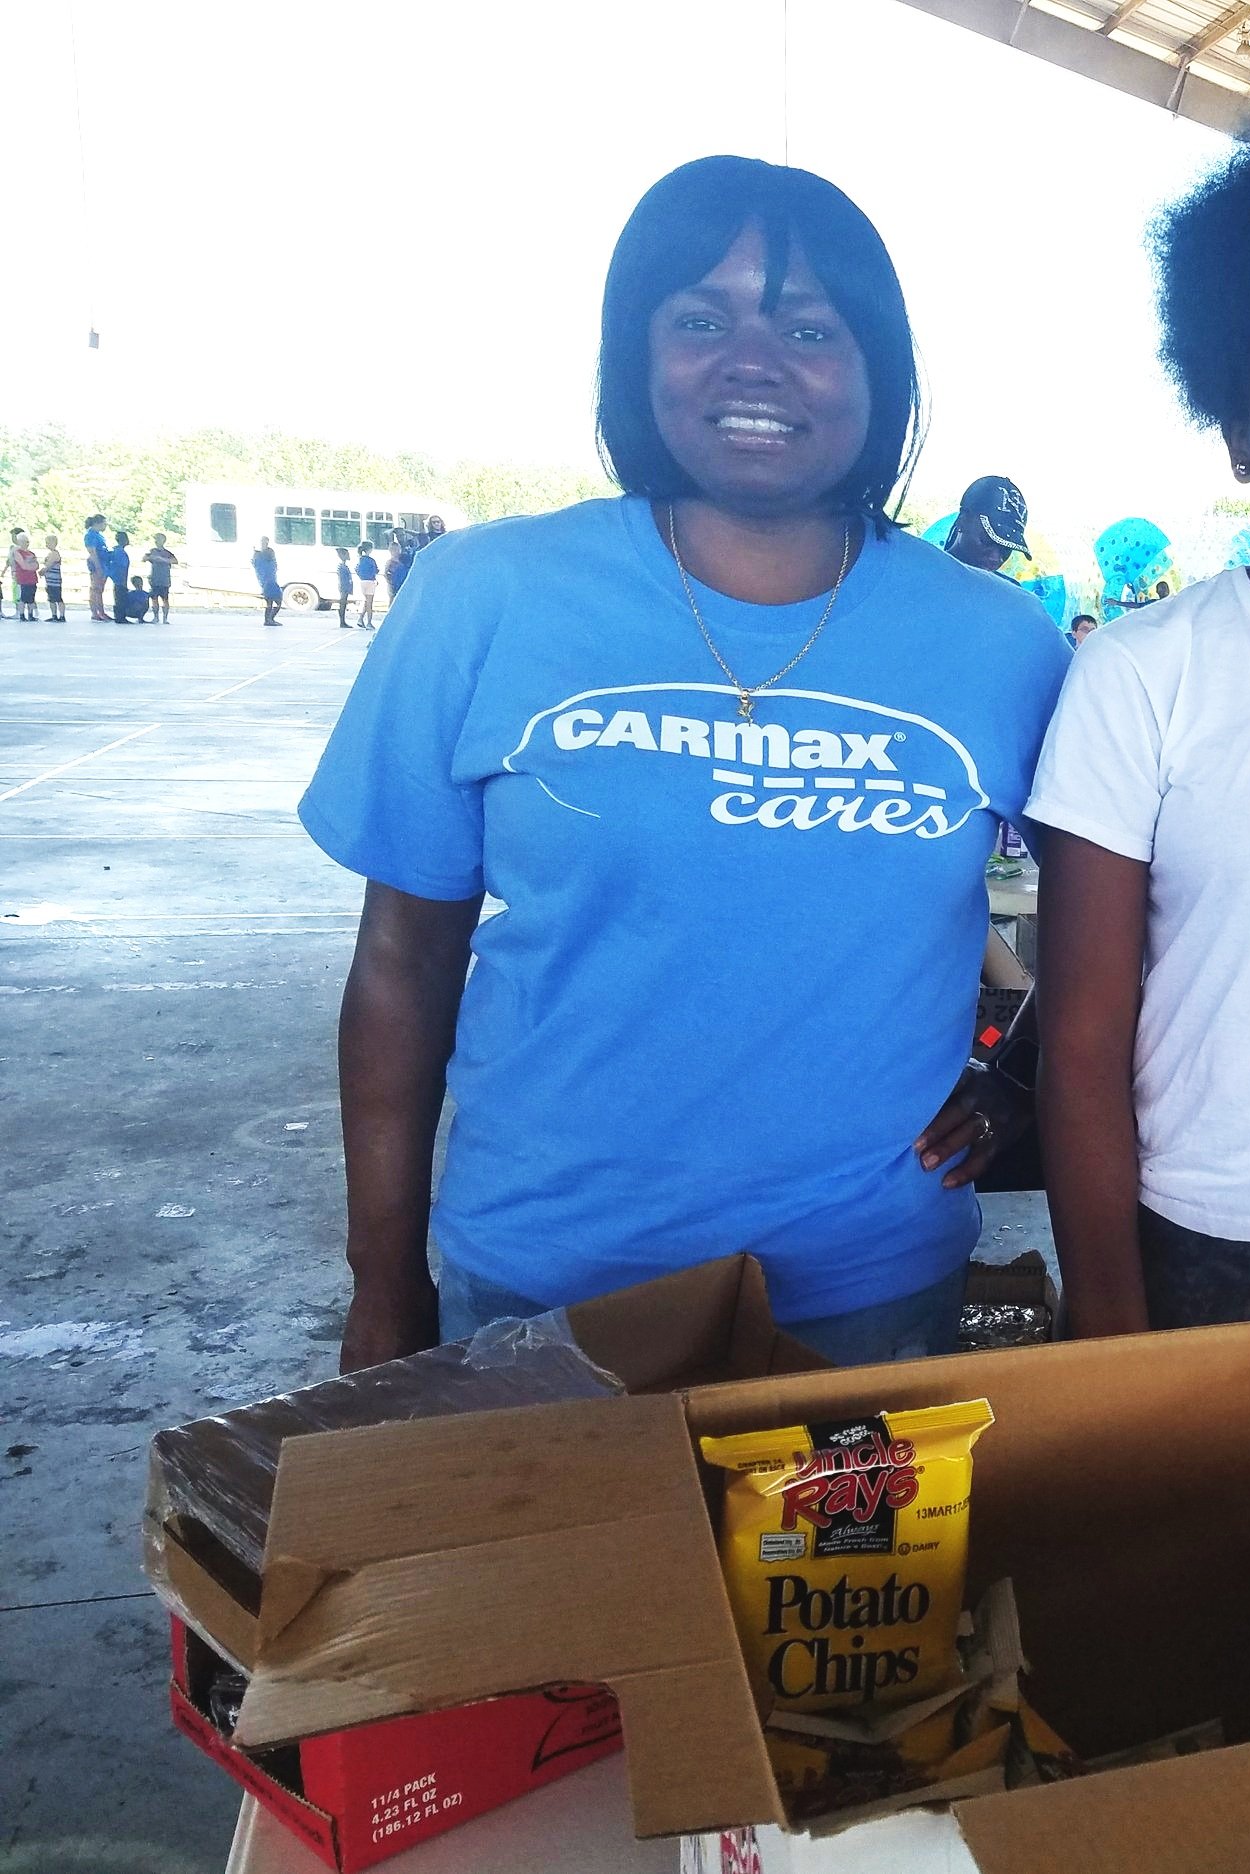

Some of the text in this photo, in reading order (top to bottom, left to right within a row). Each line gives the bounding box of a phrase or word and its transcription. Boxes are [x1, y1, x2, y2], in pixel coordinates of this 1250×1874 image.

[710, 791, 949, 840] cares
[912, 1542, 939, 1552] DAIRY
[762, 1571, 930, 1636] Potato
[767, 1634, 921, 1701] Chips
[371, 1772, 437, 1809] 11/4 PACK
[372, 1788, 437, 1825] 4.23 FL OZ
[372, 1792, 463, 1843] (186.12 FL OZ)
